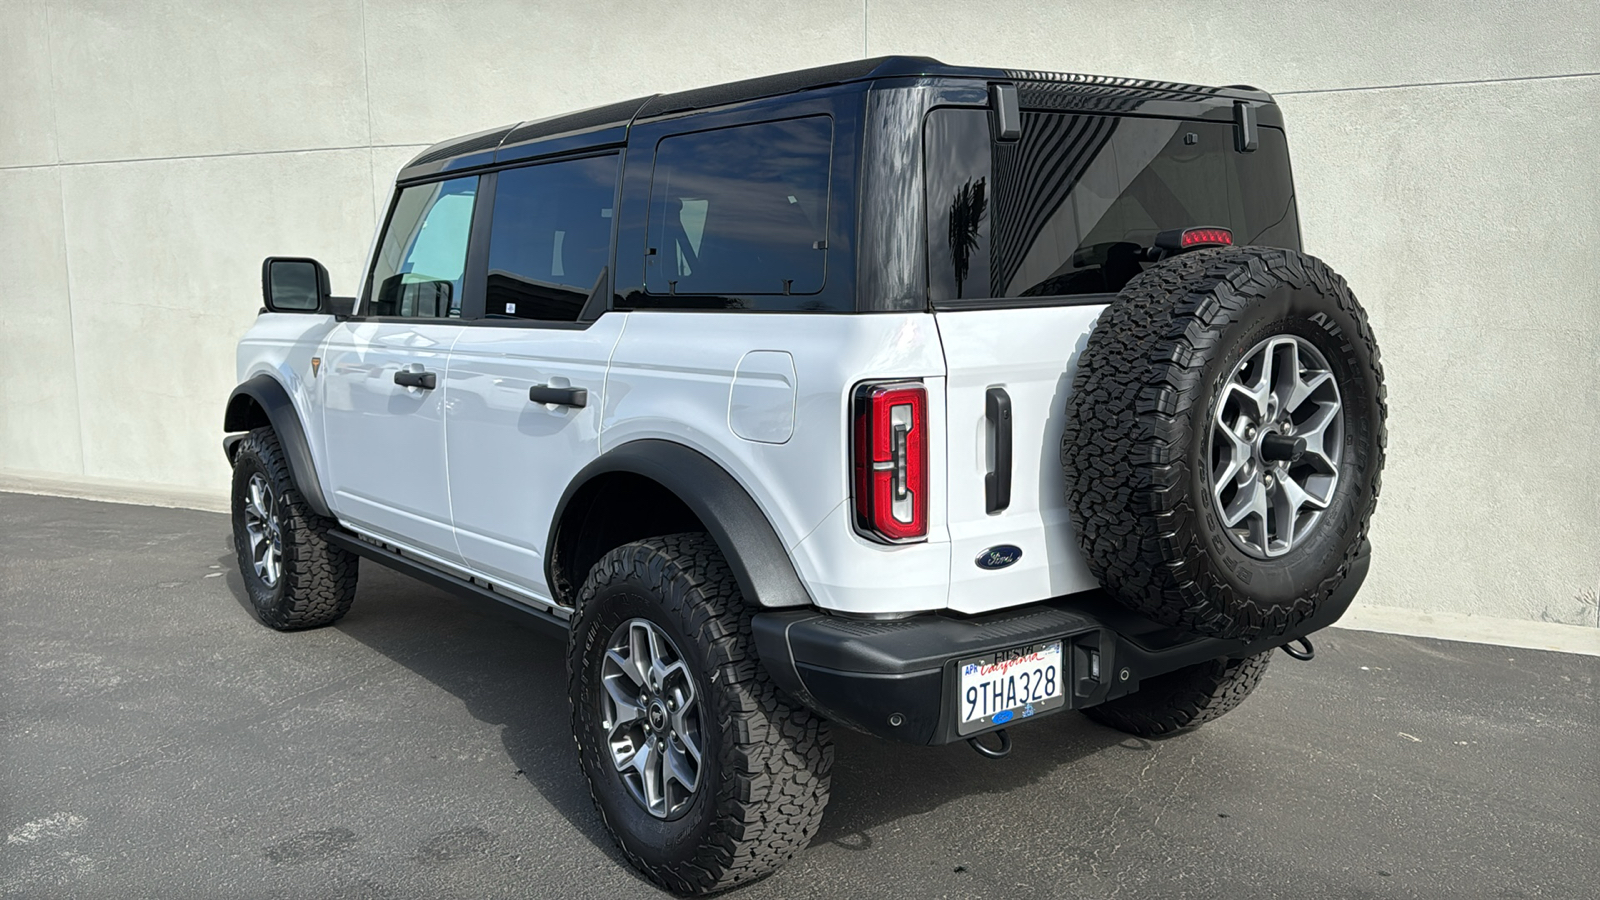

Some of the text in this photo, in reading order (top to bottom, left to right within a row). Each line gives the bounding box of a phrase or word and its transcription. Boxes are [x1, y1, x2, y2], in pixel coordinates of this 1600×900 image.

[987, 551, 1014, 566] Ford
[994, 646, 1034, 665] FIESTA
[966, 665, 1056, 721] 9THA328
